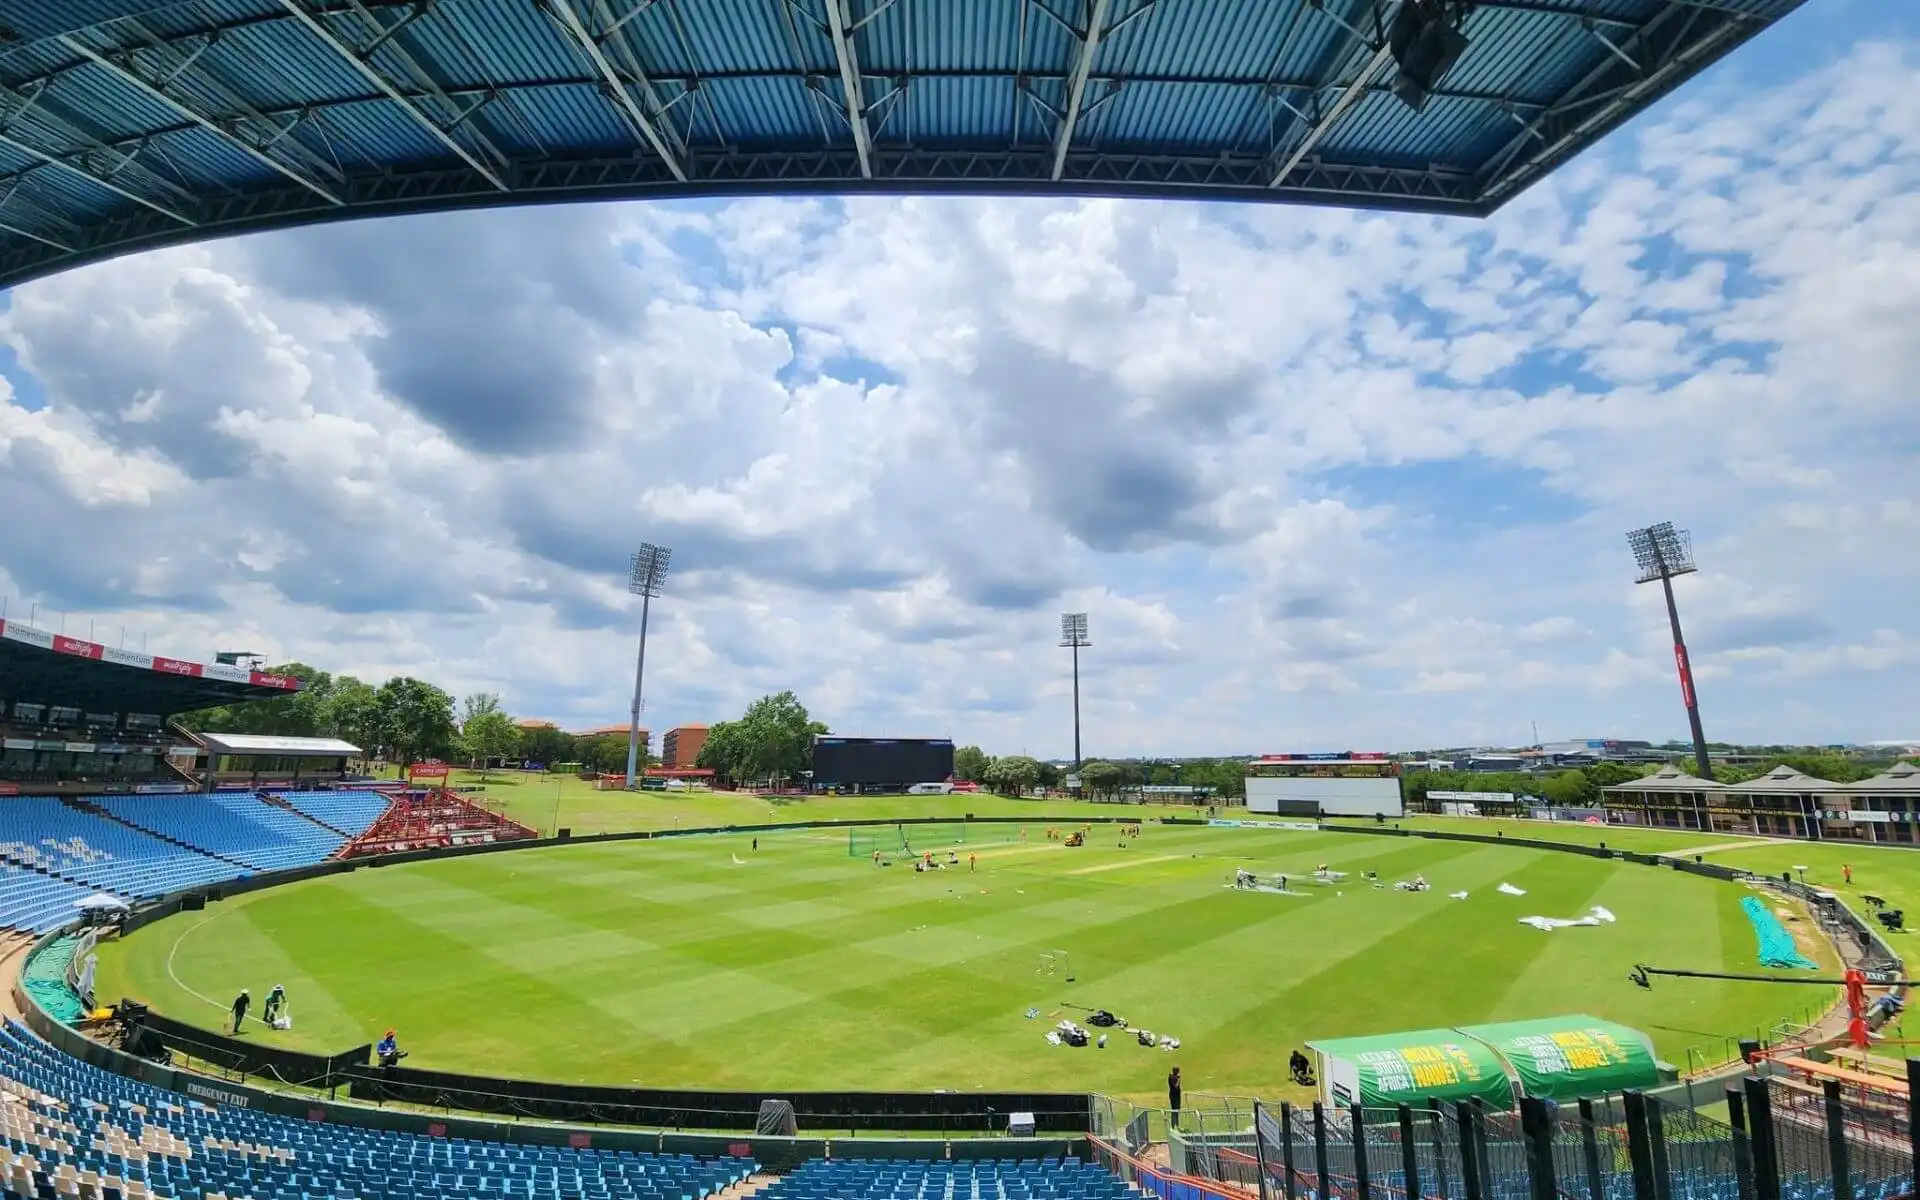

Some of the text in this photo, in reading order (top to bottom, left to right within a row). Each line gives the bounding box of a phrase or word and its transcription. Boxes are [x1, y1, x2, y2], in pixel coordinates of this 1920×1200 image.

[7, 623, 51, 643] momentum
[107, 650, 151, 664] momentum
[1373, 1060, 1406, 1076] SOUTH
[1378, 1075, 1410, 1092] AFRICA
[187, 1083, 249, 1108] EMERGENCY EXIT
